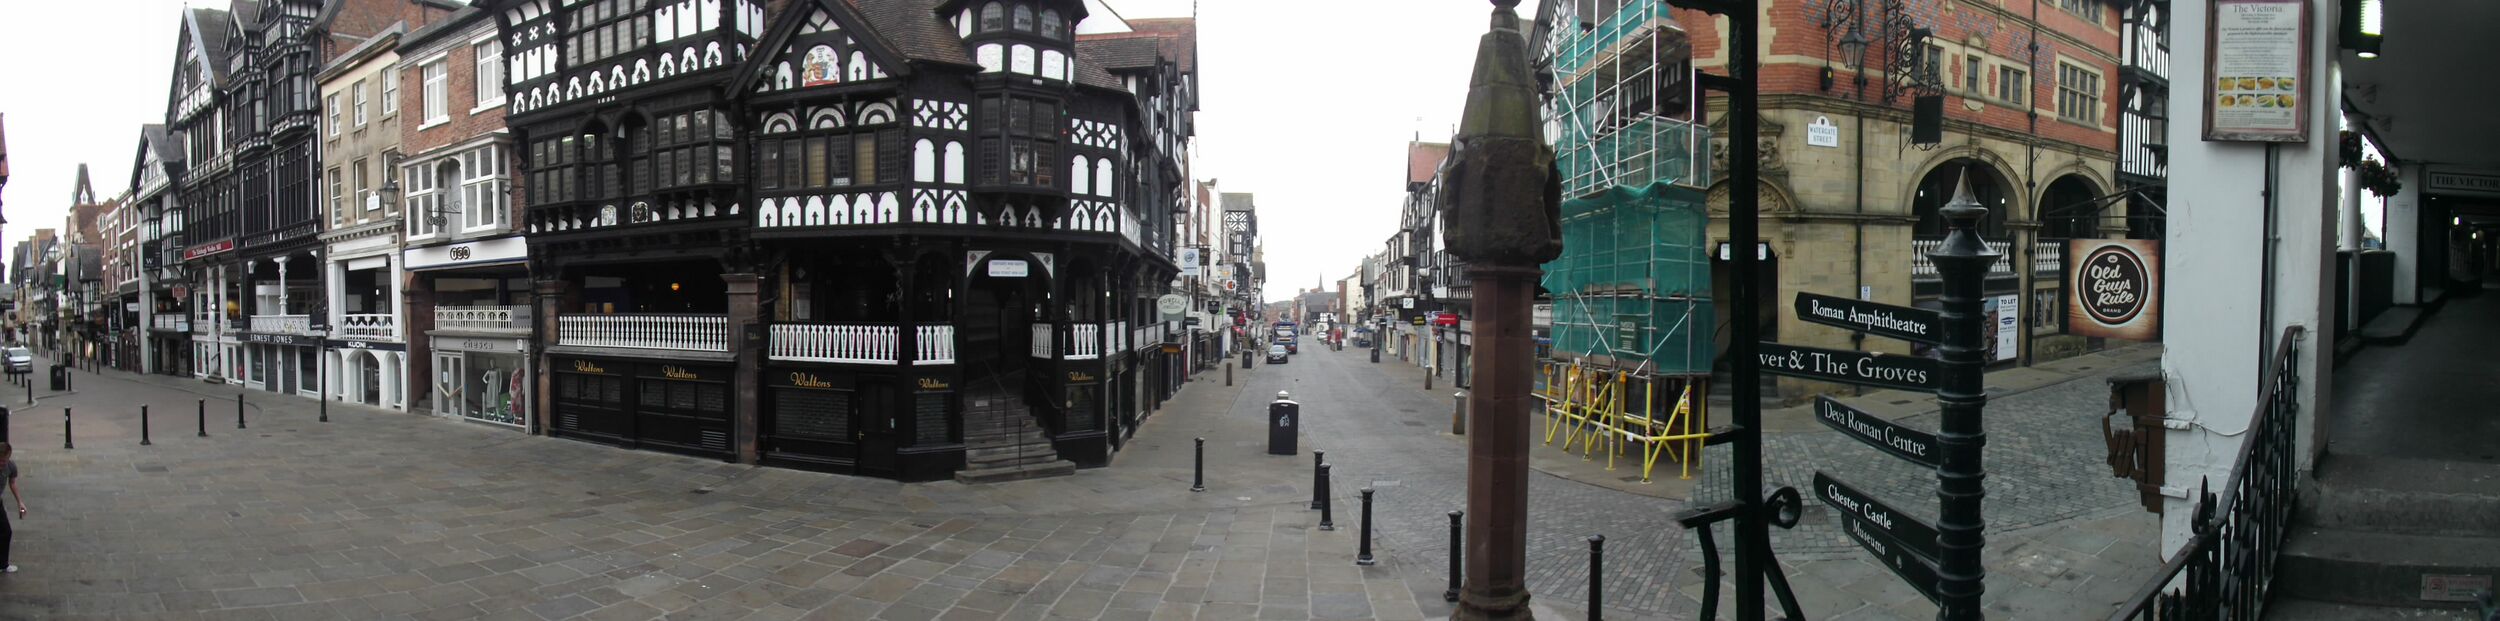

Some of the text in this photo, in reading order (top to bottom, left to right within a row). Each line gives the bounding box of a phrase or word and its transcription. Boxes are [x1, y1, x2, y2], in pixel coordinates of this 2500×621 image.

[2233, 4, 2283, 13] The Victoria
[1810, 126, 1836, 136] WATERGATE
[1813, 135, 1832, 143] STREET
[2435, 175, 2455, 185] THE
[2090, 264, 2122, 280] Old
[2093, 279, 2131, 294] Guys
[2096, 290, 2135, 307] Rule
[1812, 299, 1927, 335] Roman Amphitheatre
[250, 334, 293, 344] ERNEST JONES
[575, 360, 604, 373] Waltons
[662, 364, 697, 379] Waltons
[1759, 350, 1927, 384] ver & The Groves
[790, 372, 832, 388] Waltons
[1824, 401, 1926, 456] Deva Roman Centre
[1828, 484, 1892, 530] Chester Castle
[1852, 519, 1886, 556] Museums
